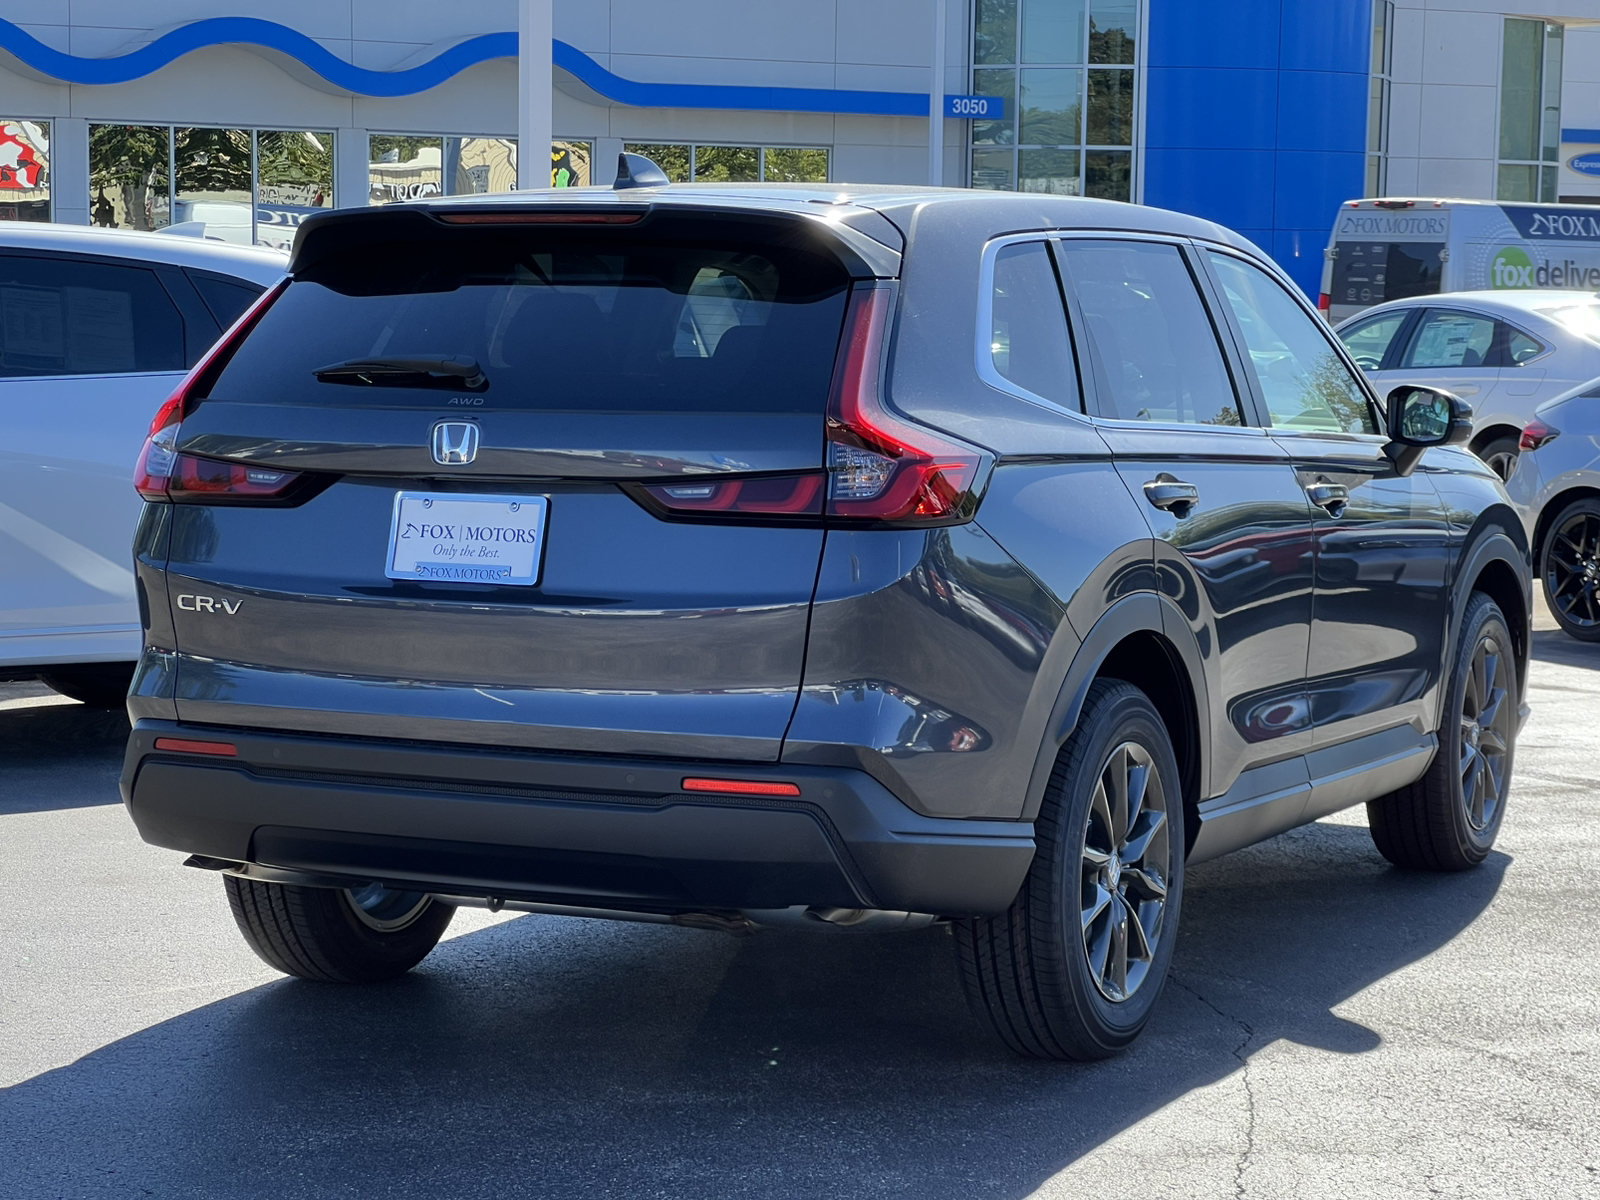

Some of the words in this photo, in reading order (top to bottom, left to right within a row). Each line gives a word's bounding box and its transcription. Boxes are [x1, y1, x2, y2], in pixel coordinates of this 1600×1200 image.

[952, 98, 988, 115] 3050
[1354, 217, 1383, 234] FOX
[1384, 217, 1446, 234] MOTORS
[1547, 215, 1588, 237] FOX
[1493, 257, 1532, 287] fox
[448, 397, 484, 406] AWD
[420, 524, 456, 540] FOX
[465, 526, 536, 544] MOTORS
[432, 543, 458, 560] Only
[460, 544, 476, 557] the
[477, 545, 500, 559] Best.
[430, 566, 453, 579] FOX
[454, 569, 502, 581] MOTORS
[177, 594, 244, 615] CR-V
